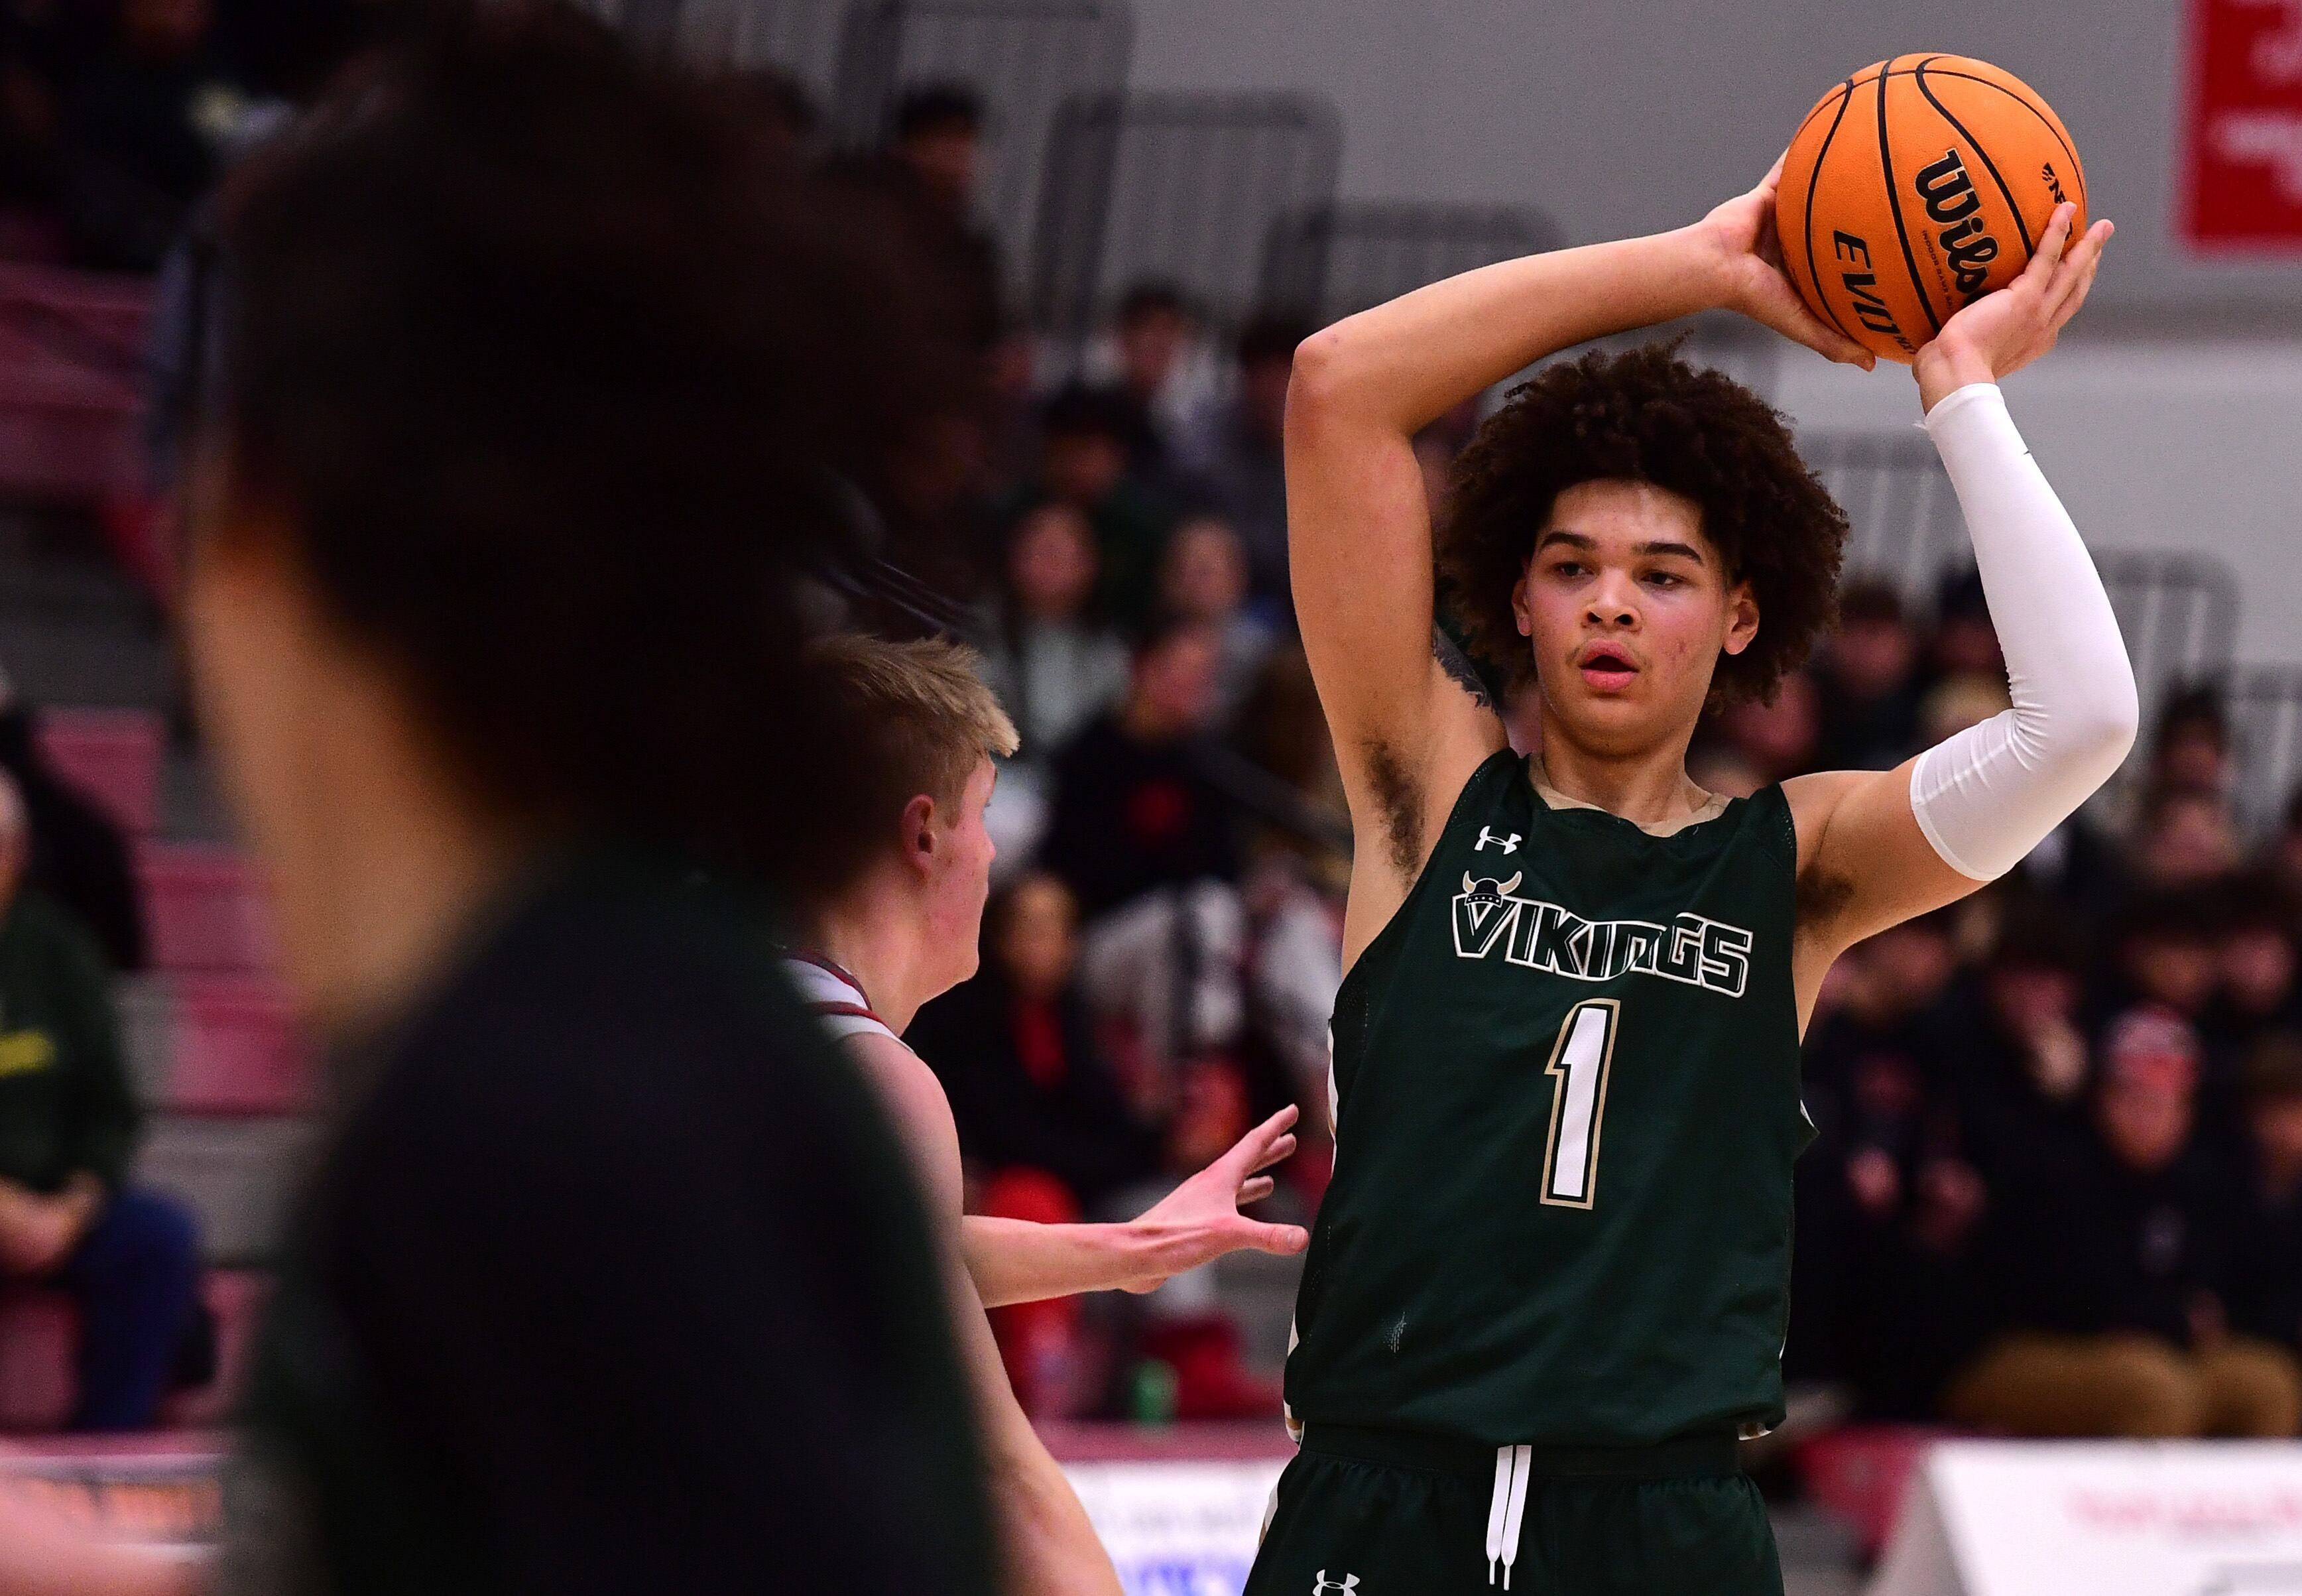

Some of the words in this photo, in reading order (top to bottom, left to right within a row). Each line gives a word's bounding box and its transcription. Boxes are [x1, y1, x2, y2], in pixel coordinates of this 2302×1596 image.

[1833, 229, 1901, 334] EVO
[1915, 147, 1999, 313] Wils
[1923, 230, 1939, 266] INDOOR
[1452, 894, 1754, 999] VIKINGS
[1539, 997, 1621, 1210] 1
